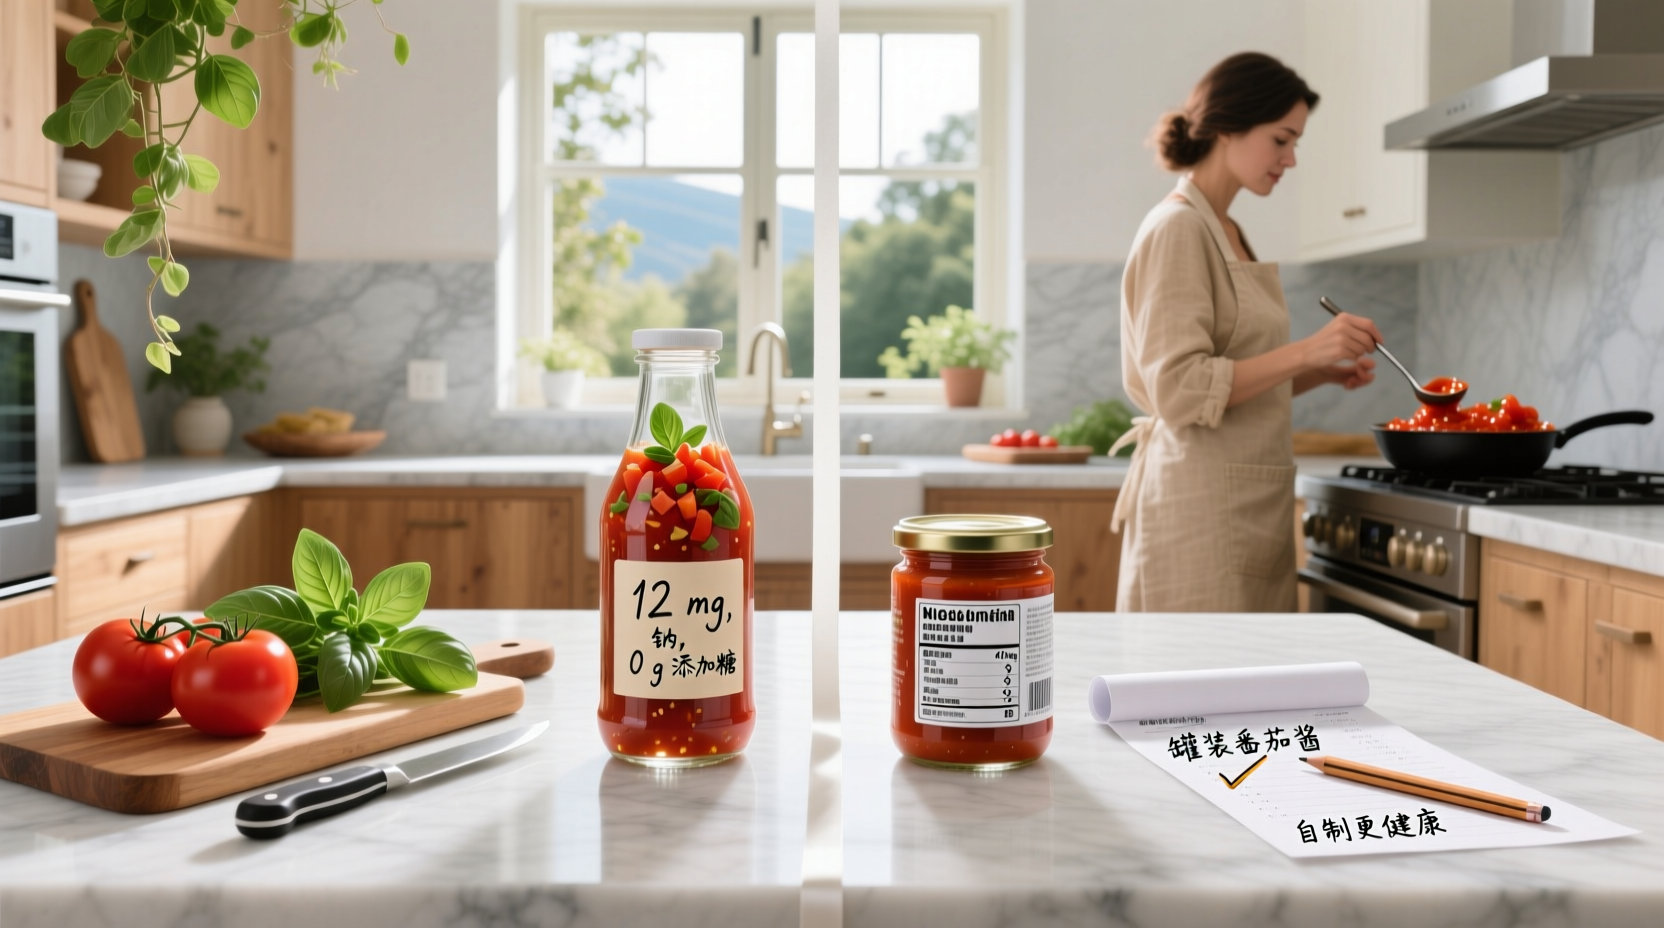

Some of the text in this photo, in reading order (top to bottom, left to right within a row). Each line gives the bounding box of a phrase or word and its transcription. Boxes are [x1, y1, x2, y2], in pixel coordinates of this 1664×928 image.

[633, 579, 732, 633] 12 mg,
[630, 649, 737, 687] 0 g 添加糖
[1168, 724, 1320, 762] 罐装番茄酱
[1297, 808, 1447, 843] 自制更健康
